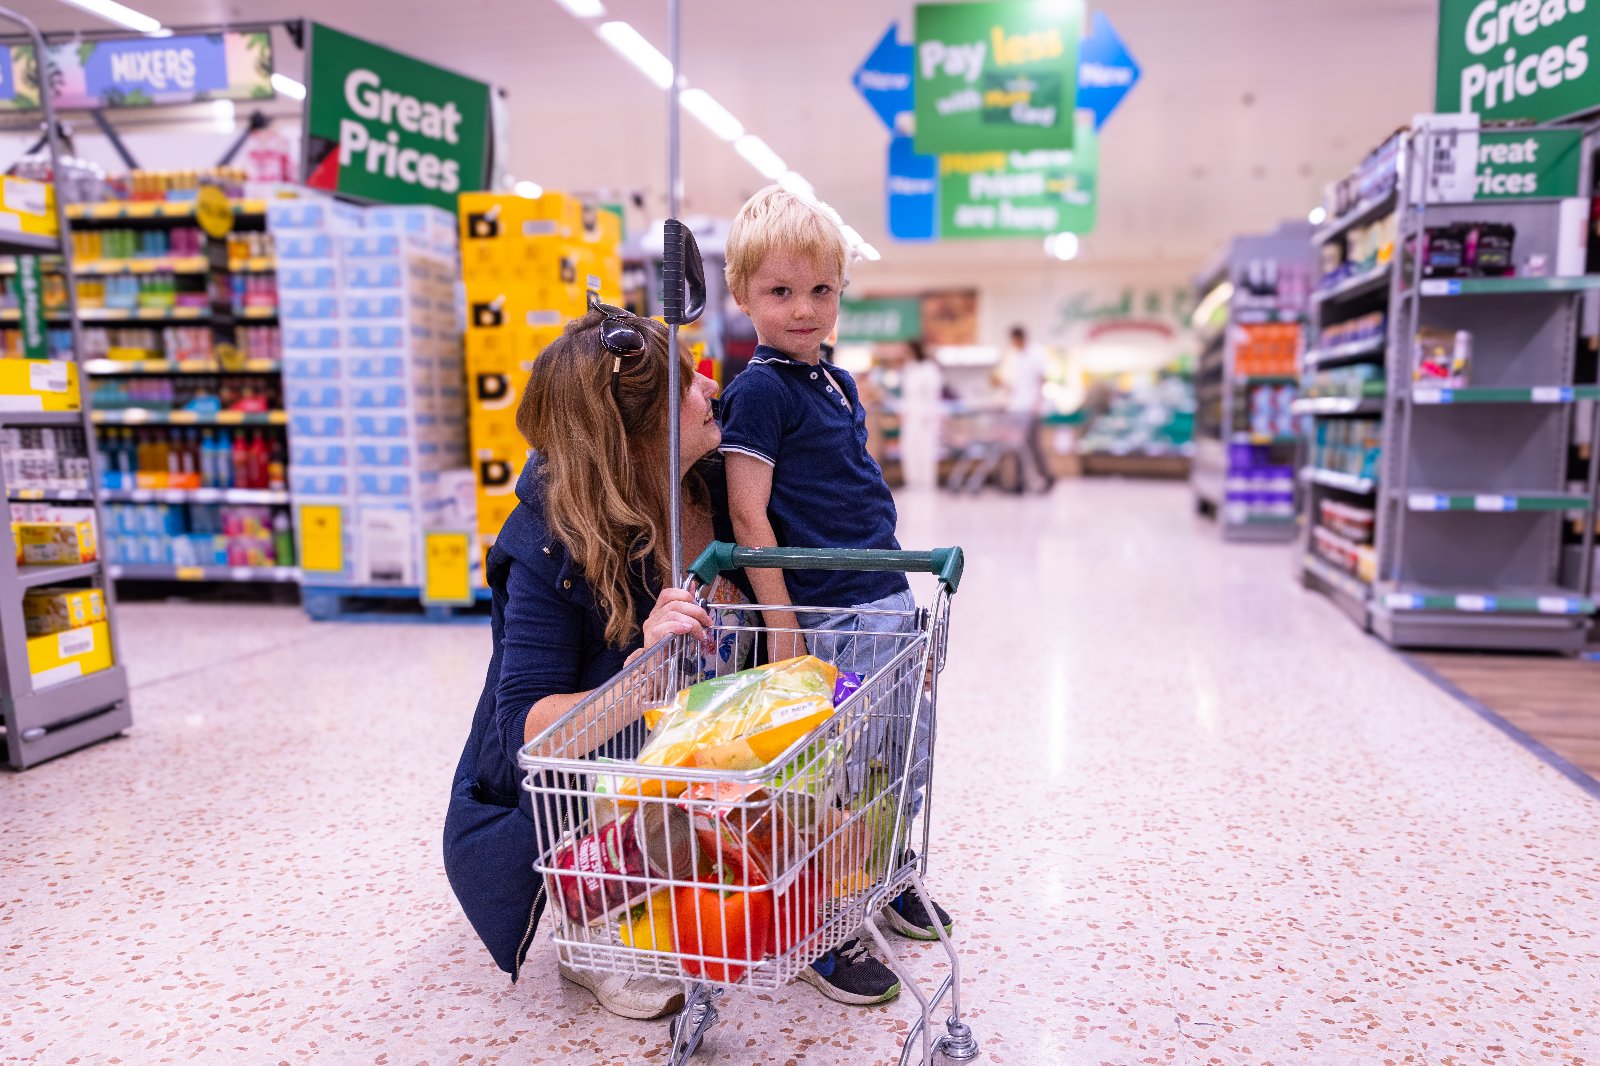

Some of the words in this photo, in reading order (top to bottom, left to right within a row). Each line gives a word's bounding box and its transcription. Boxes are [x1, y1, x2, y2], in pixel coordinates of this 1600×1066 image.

[110, 49, 196, 89] MIXERS
[919, 40, 986, 82] Pay
[991, 26, 1062, 67] less
[1460, 35, 1588, 115] Prices
[344, 68, 463, 145] Great
[338, 119, 461, 194] Prices
[1475, 138, 1539, 164] reat
[1473, 168, 1537, 194] rices
